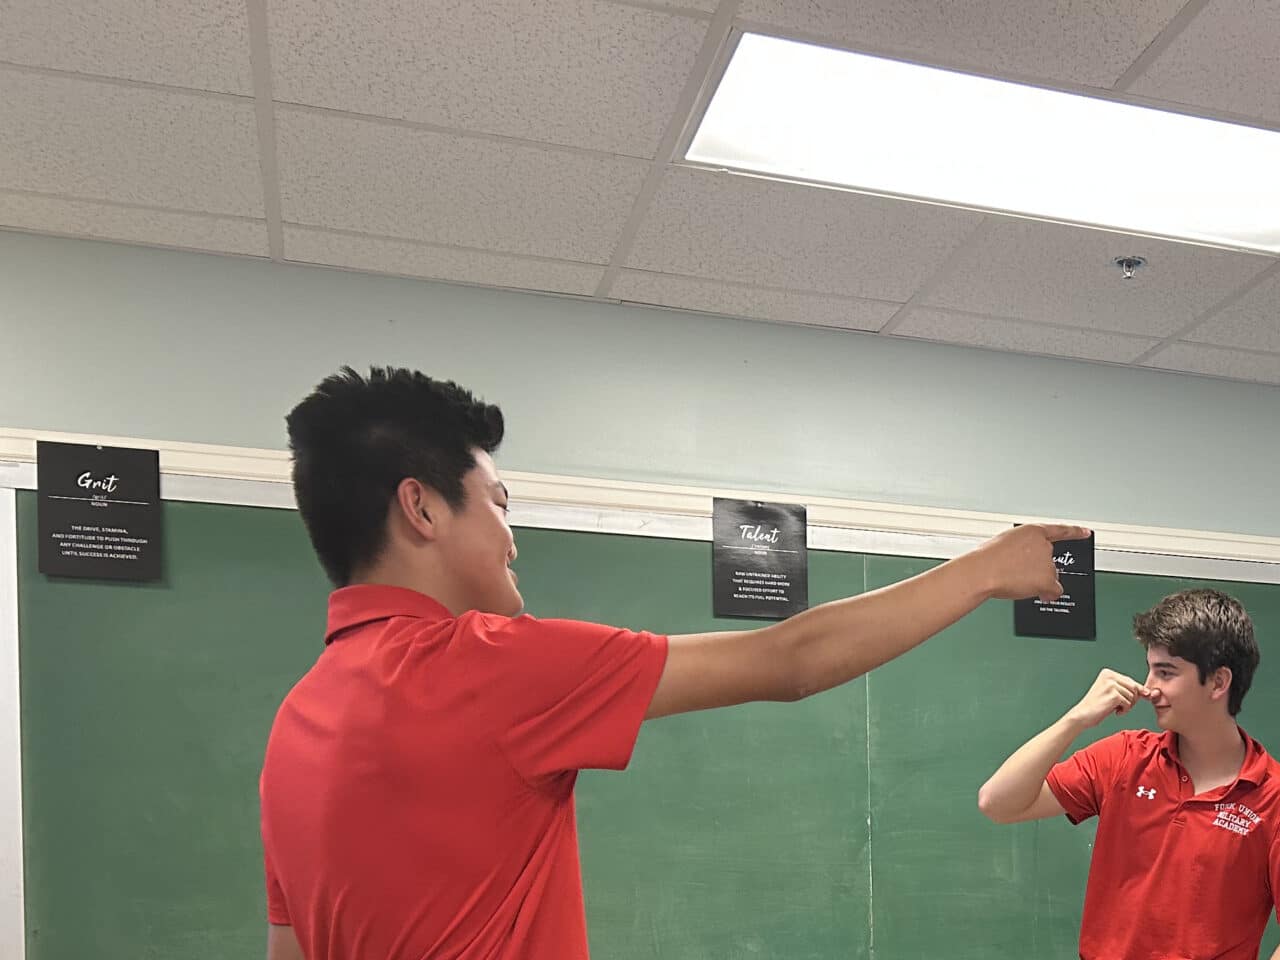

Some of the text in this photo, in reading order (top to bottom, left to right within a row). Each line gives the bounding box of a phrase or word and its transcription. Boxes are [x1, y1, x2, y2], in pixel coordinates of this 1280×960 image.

[77, 472, 119, 493] Grit
[740, 525, 781, 544] Talent
[1052, 551, 1076, 565] cute
[1214, 802, 1262, 824] FORK UNION
[1217, 811, 1252, 828] MILITARY
[1212, 818, 1249, 836] ACADEMY
